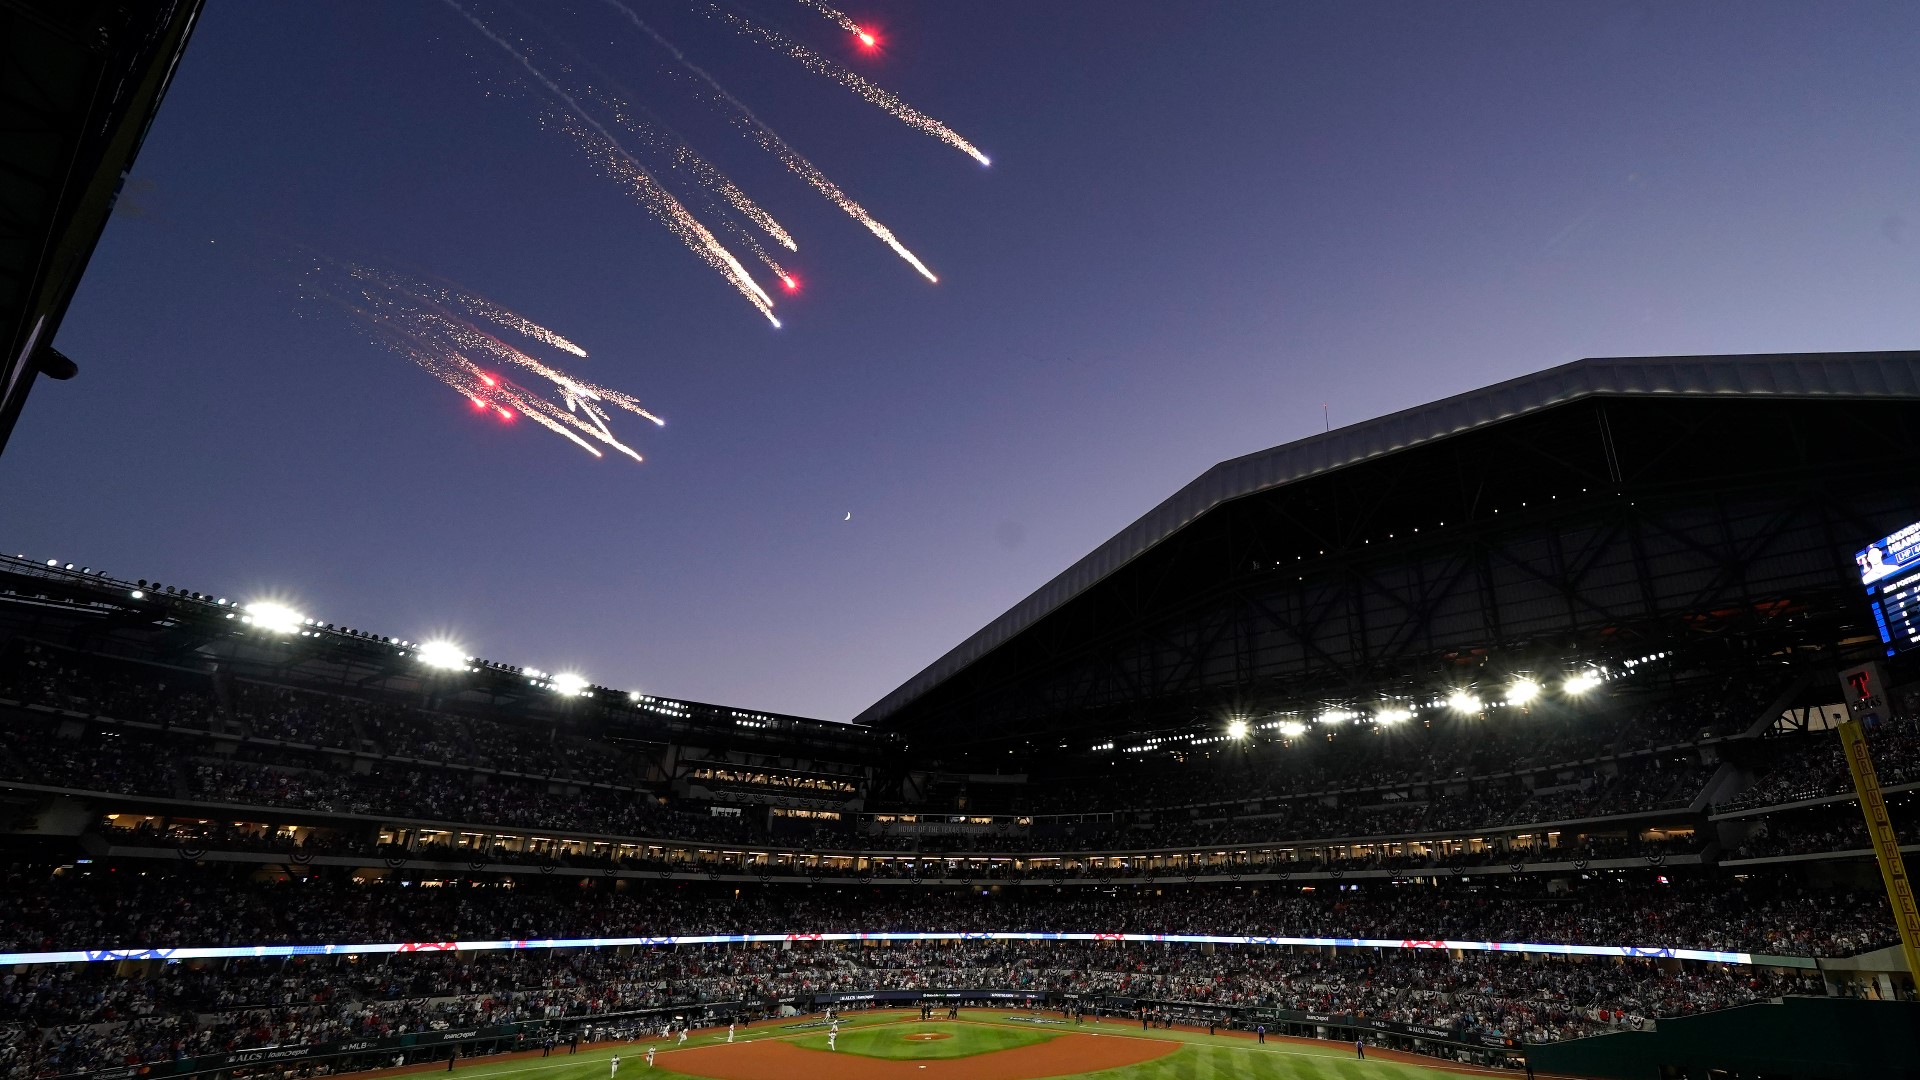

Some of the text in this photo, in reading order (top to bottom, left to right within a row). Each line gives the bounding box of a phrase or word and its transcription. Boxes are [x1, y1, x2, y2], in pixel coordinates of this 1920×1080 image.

[1847, 672, 1870, 698] T
[1853, 696, 1882, 712] TEXAS
[1854, 744, 1885, 821] BRING
[1879, 826, 1901, 874] THE
[941, 826, 960, 834] TEXAS
[348, 1042, 367, 1050] MLB
[235, 1048, 310, 1062] ALCS loanDepot
